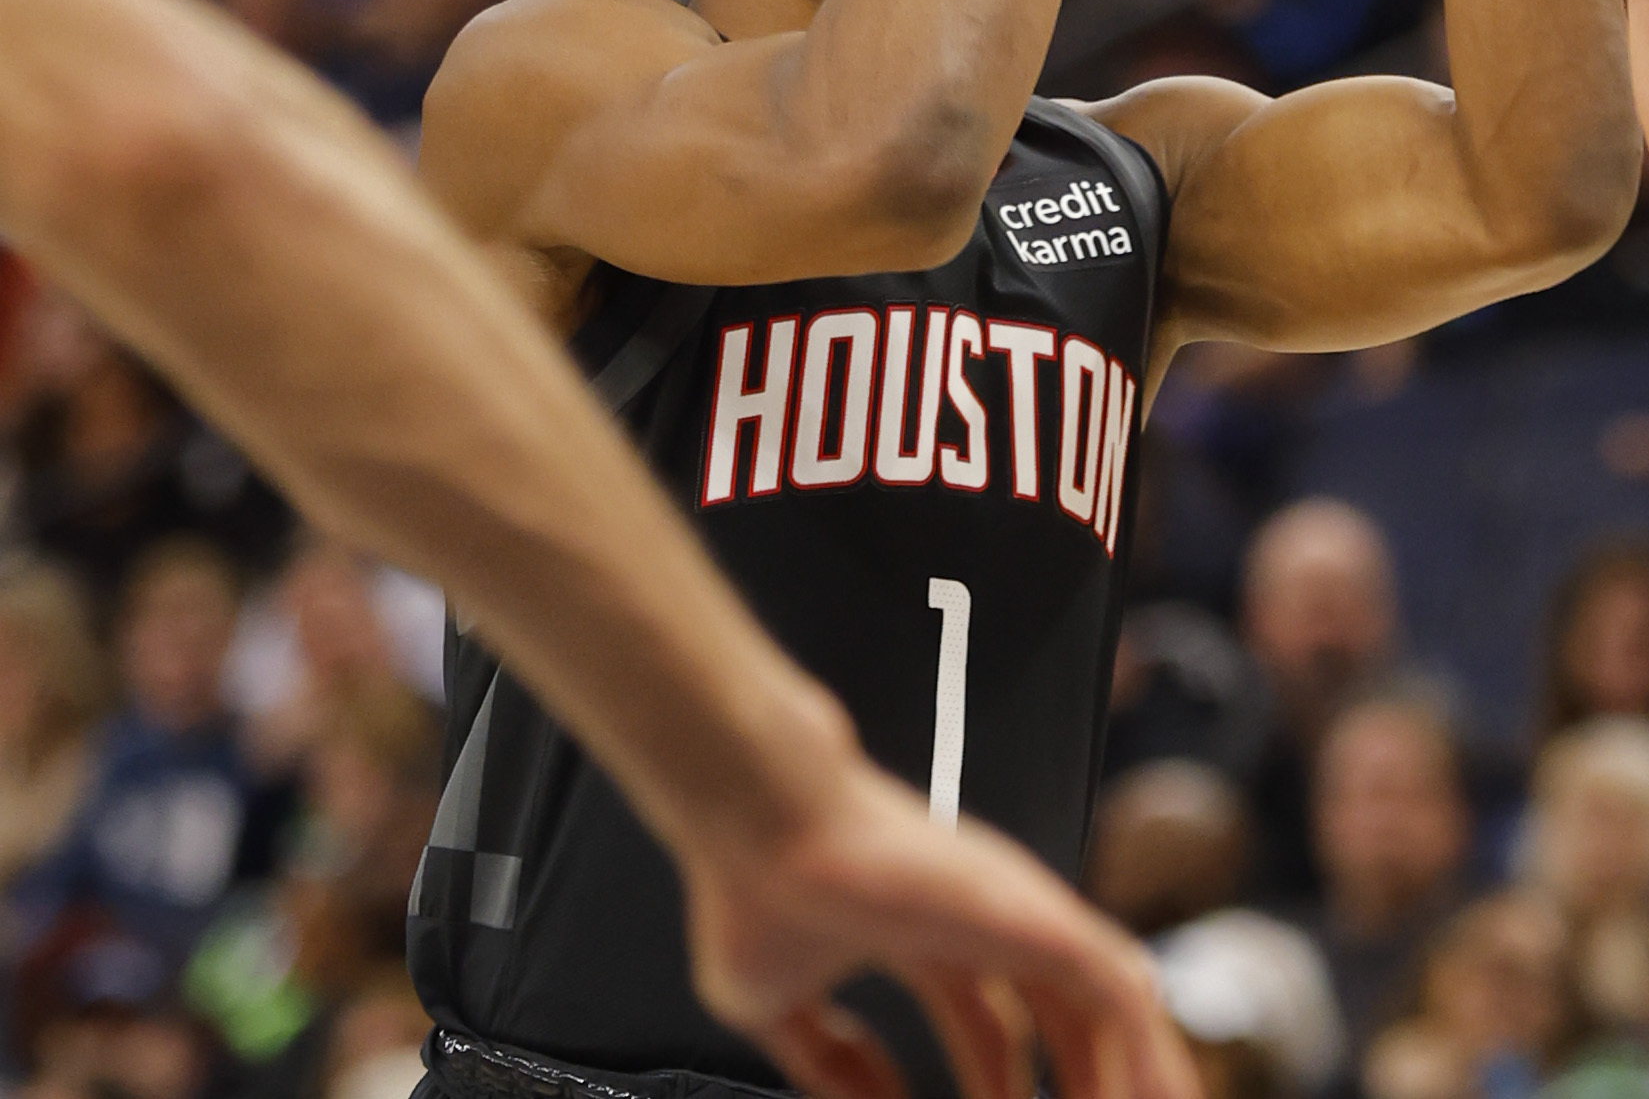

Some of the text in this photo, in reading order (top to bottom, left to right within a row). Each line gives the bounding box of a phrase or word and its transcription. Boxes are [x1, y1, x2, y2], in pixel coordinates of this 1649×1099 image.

[999, 180, 1121, 231] credit
[1006, 222, 1133, 266] karma
[701, 305, 1136, 560] HOUSTON
[928, 576, 972, 830] 1
